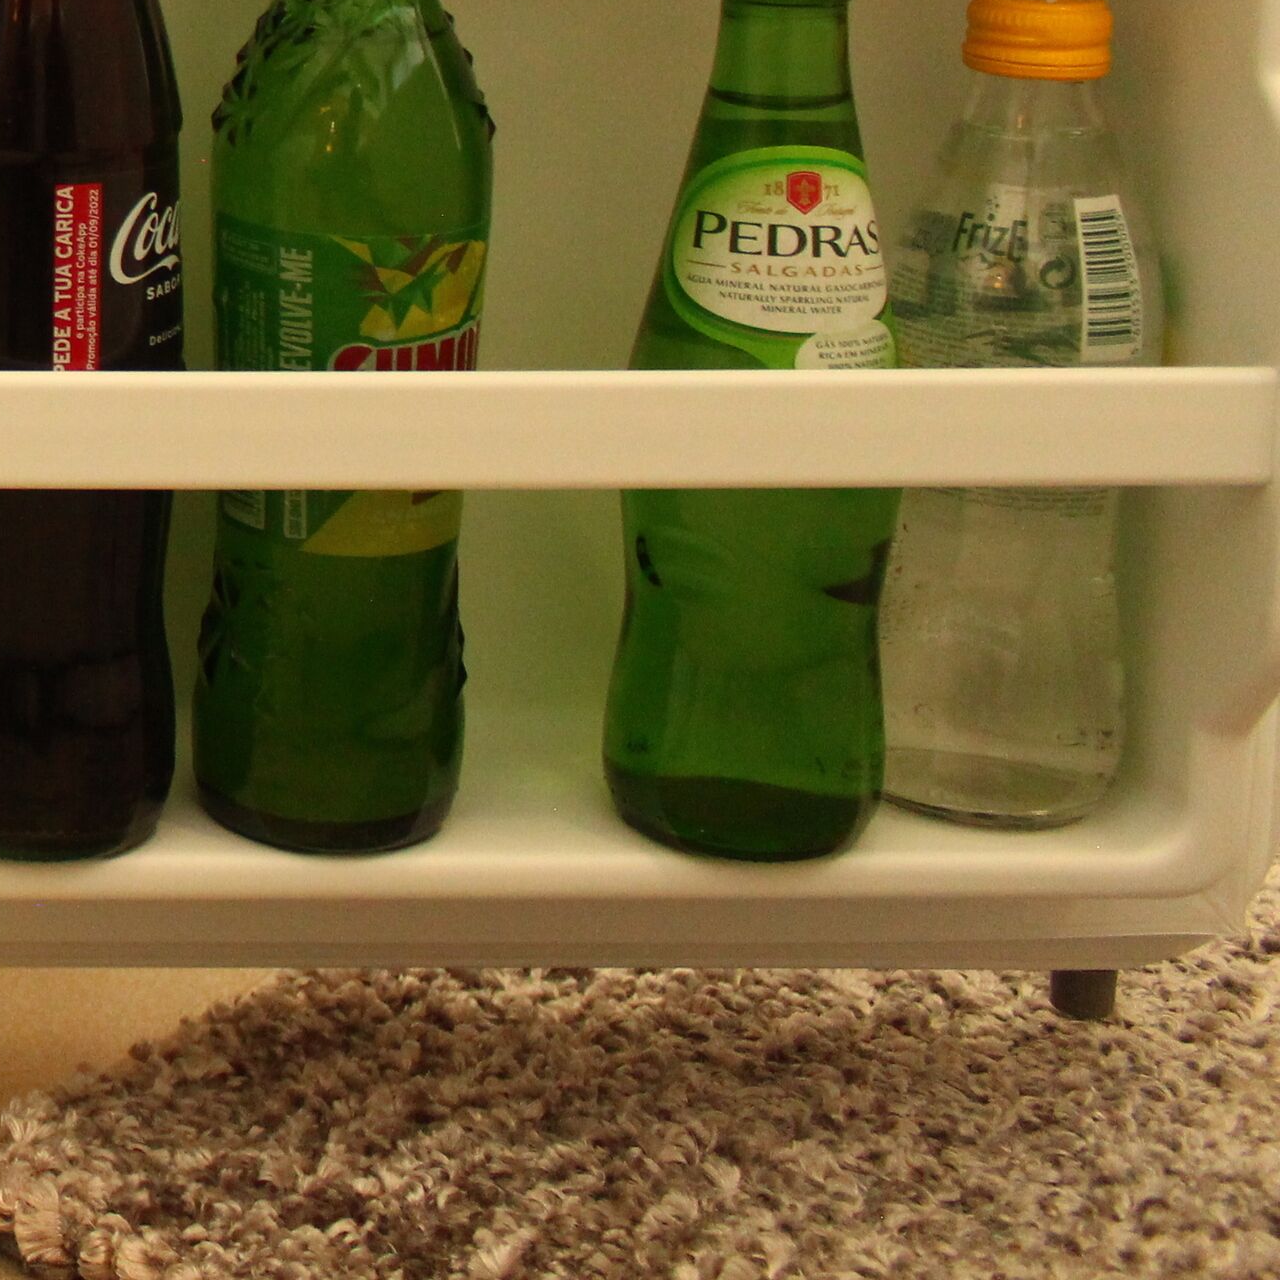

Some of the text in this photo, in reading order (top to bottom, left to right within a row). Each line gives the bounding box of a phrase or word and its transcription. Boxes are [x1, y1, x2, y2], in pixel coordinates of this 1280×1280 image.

[55, 186, 74, 259] CARICA
[693, 209, 880, 258] PEDRAS
[54, 264, 73, 303] TUA
[77, 271, 85, 283] na
[86, 189, 100, 370] Promoção válida até dia 01/09/2022
[715, 279, 764, 291] MINERAL
[769, 283, 821, 293] NATURAL
[727, 262, 863, 278] SALGADAS
[54, 307, 72, 321] A
[75, 285, 87, 331] participa
